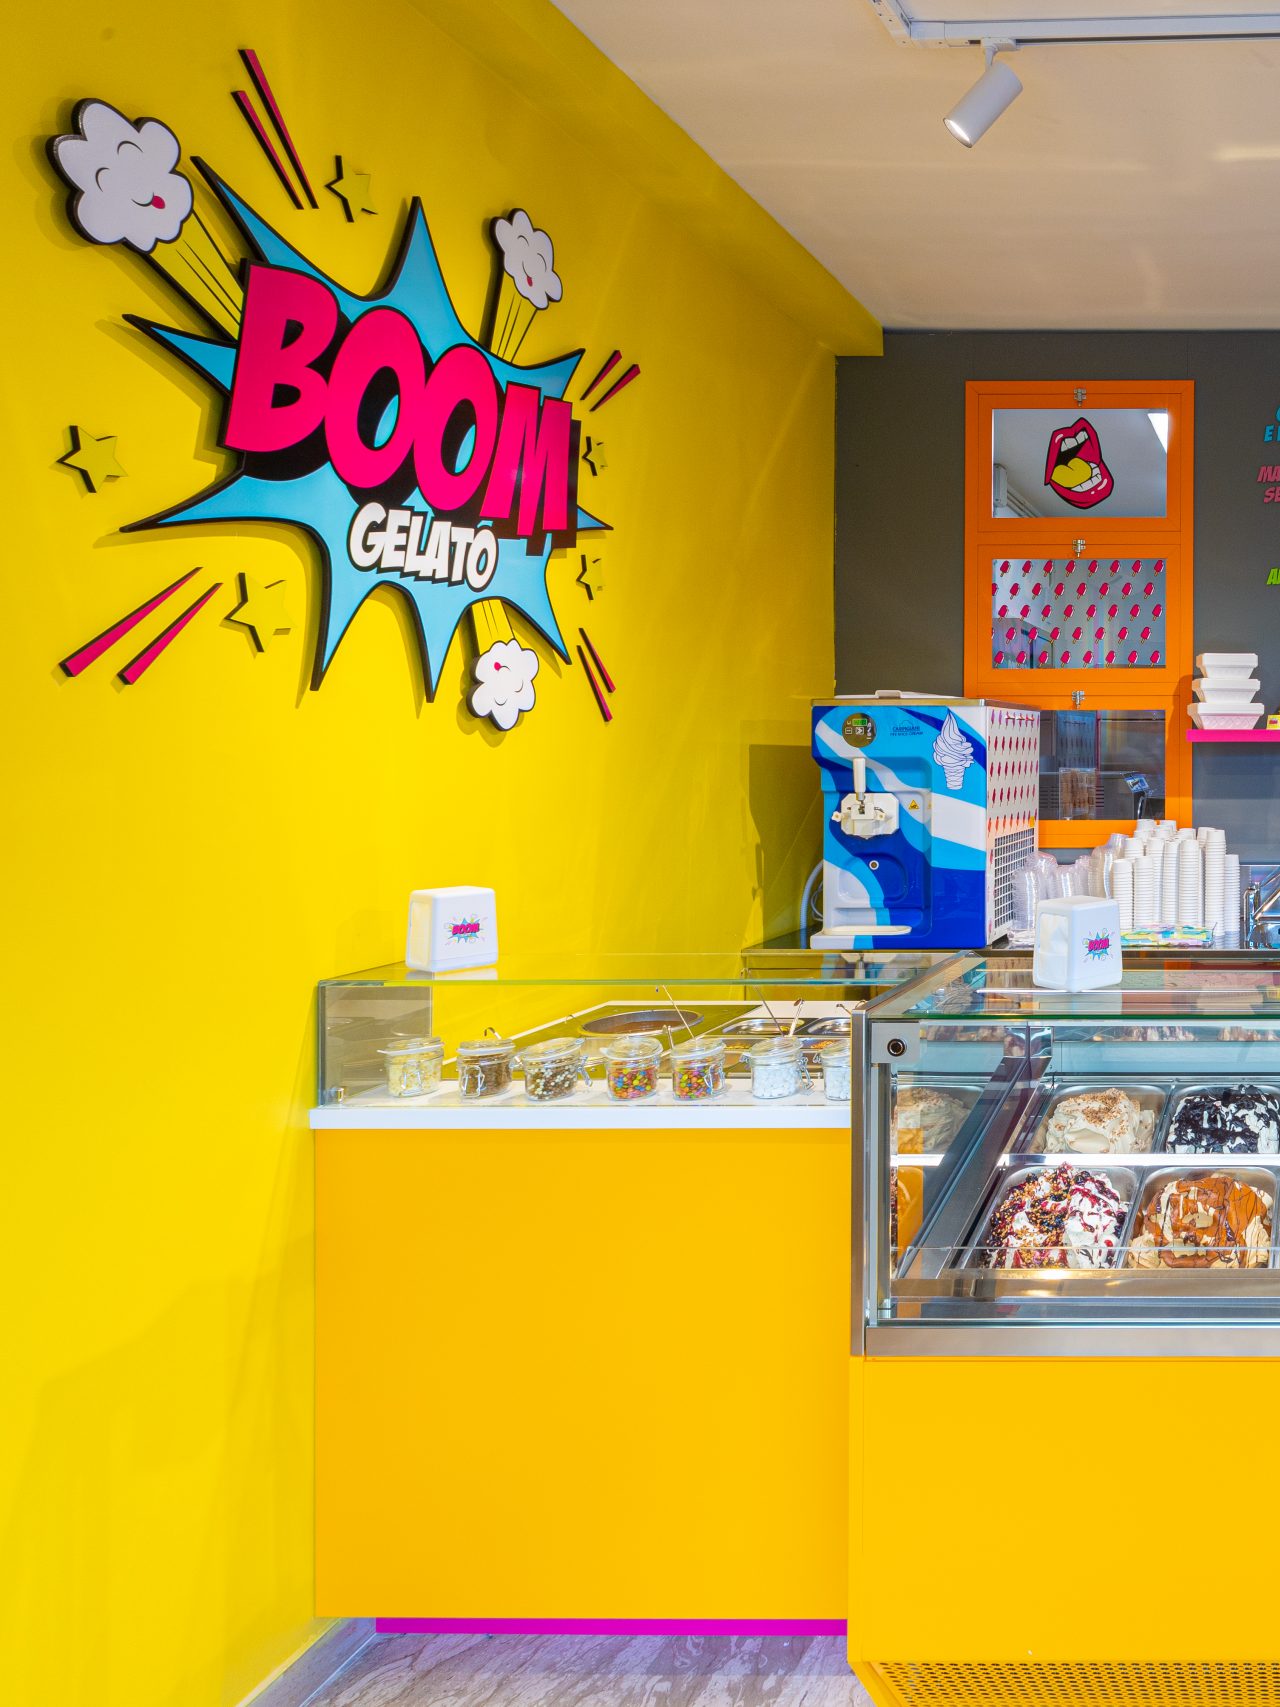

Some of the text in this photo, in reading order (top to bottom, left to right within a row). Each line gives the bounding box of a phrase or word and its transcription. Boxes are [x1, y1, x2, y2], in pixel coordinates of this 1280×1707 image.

[222, 261, 577, 543] BOOM
[1264, 424, 1274, 442] E
[349, 501, 498, 590] GELATO
